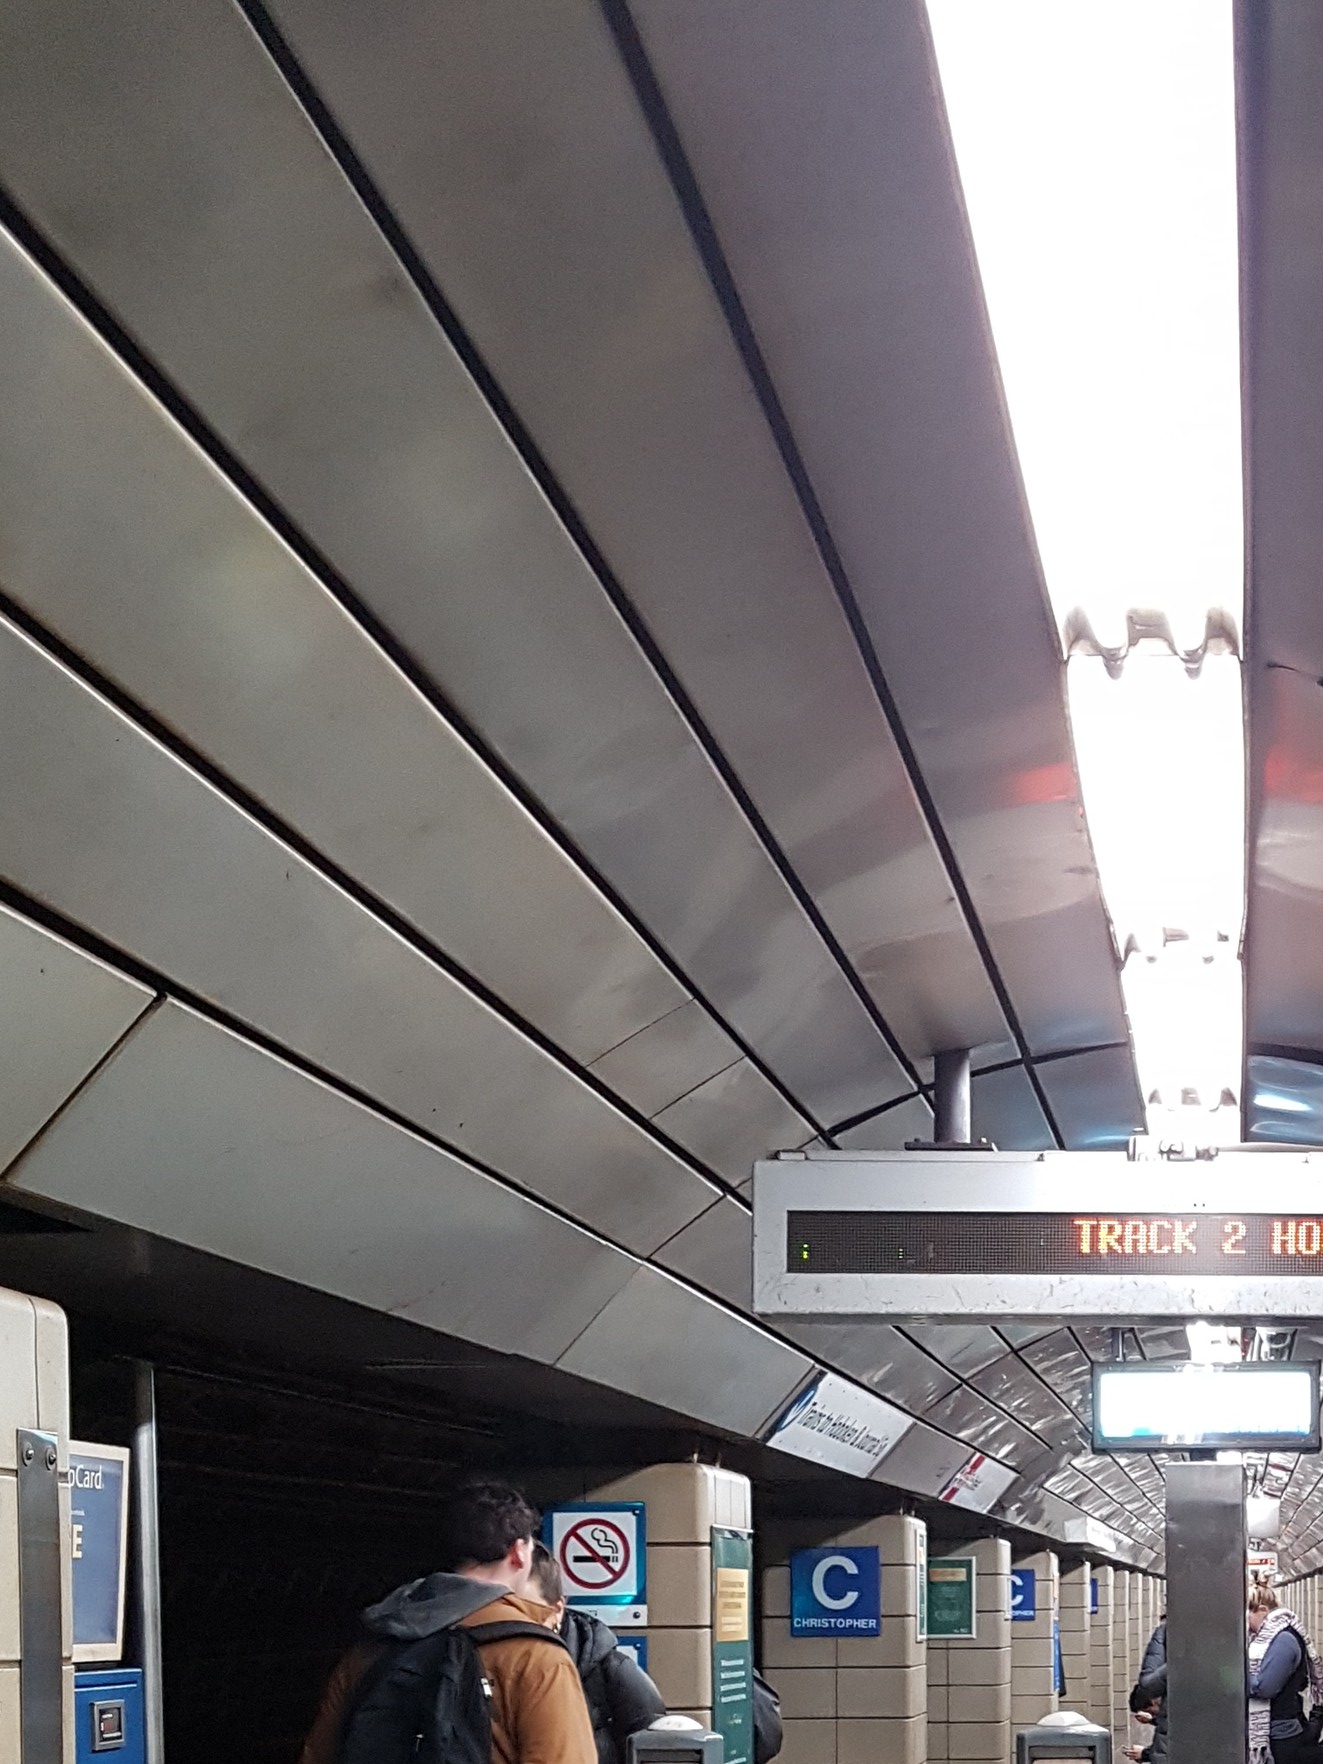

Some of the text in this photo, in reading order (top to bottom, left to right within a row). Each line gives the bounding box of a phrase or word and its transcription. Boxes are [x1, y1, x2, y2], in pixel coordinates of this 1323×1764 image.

[1074, 1219, 1198, 1255] TRACK
[1222, 1221, 1247, 1256] 2
[812, 1555, 859, 1610] C
[793, 1618, 877, 1629] CHRISTOPHER
